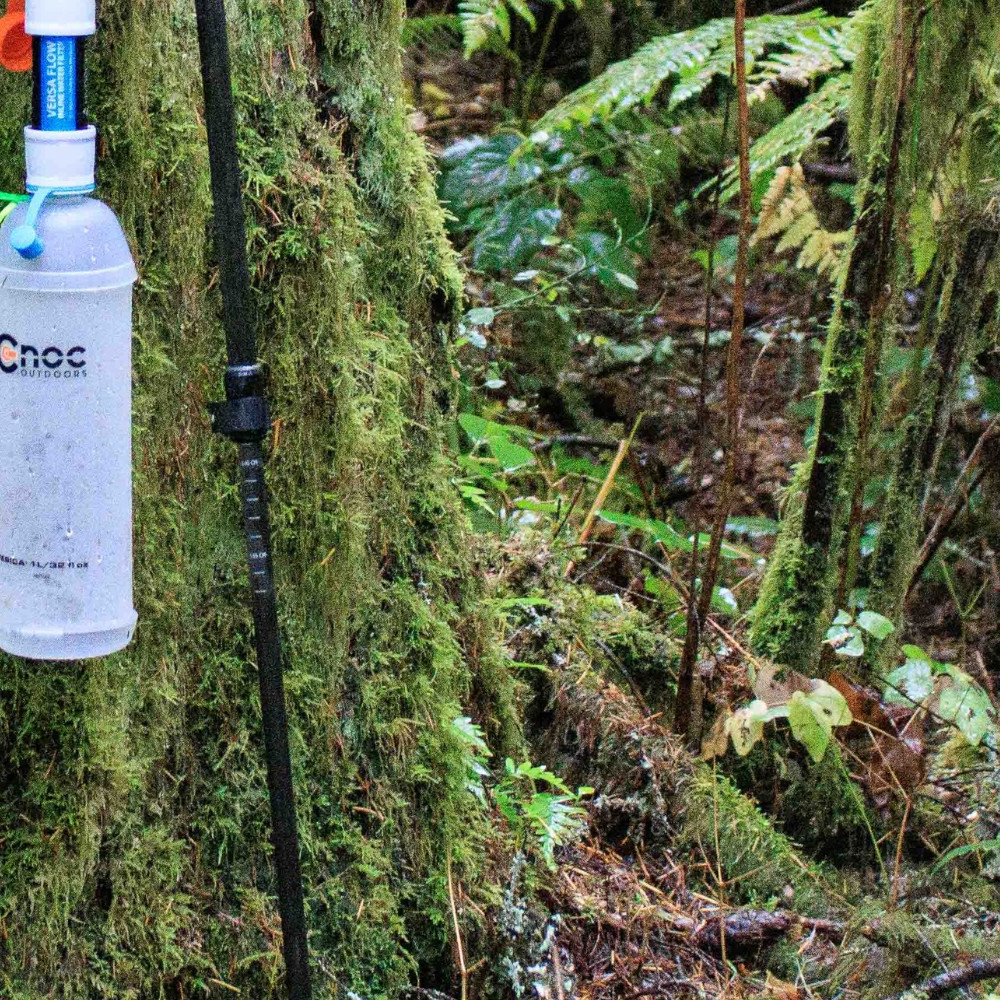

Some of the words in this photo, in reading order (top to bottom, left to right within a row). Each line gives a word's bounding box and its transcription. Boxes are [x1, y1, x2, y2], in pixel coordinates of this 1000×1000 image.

[46, 41, 57, 76] FLOW
[46, 78, 57, 118] VERSA
[20, 369, 87, 378] OUTDOORS
